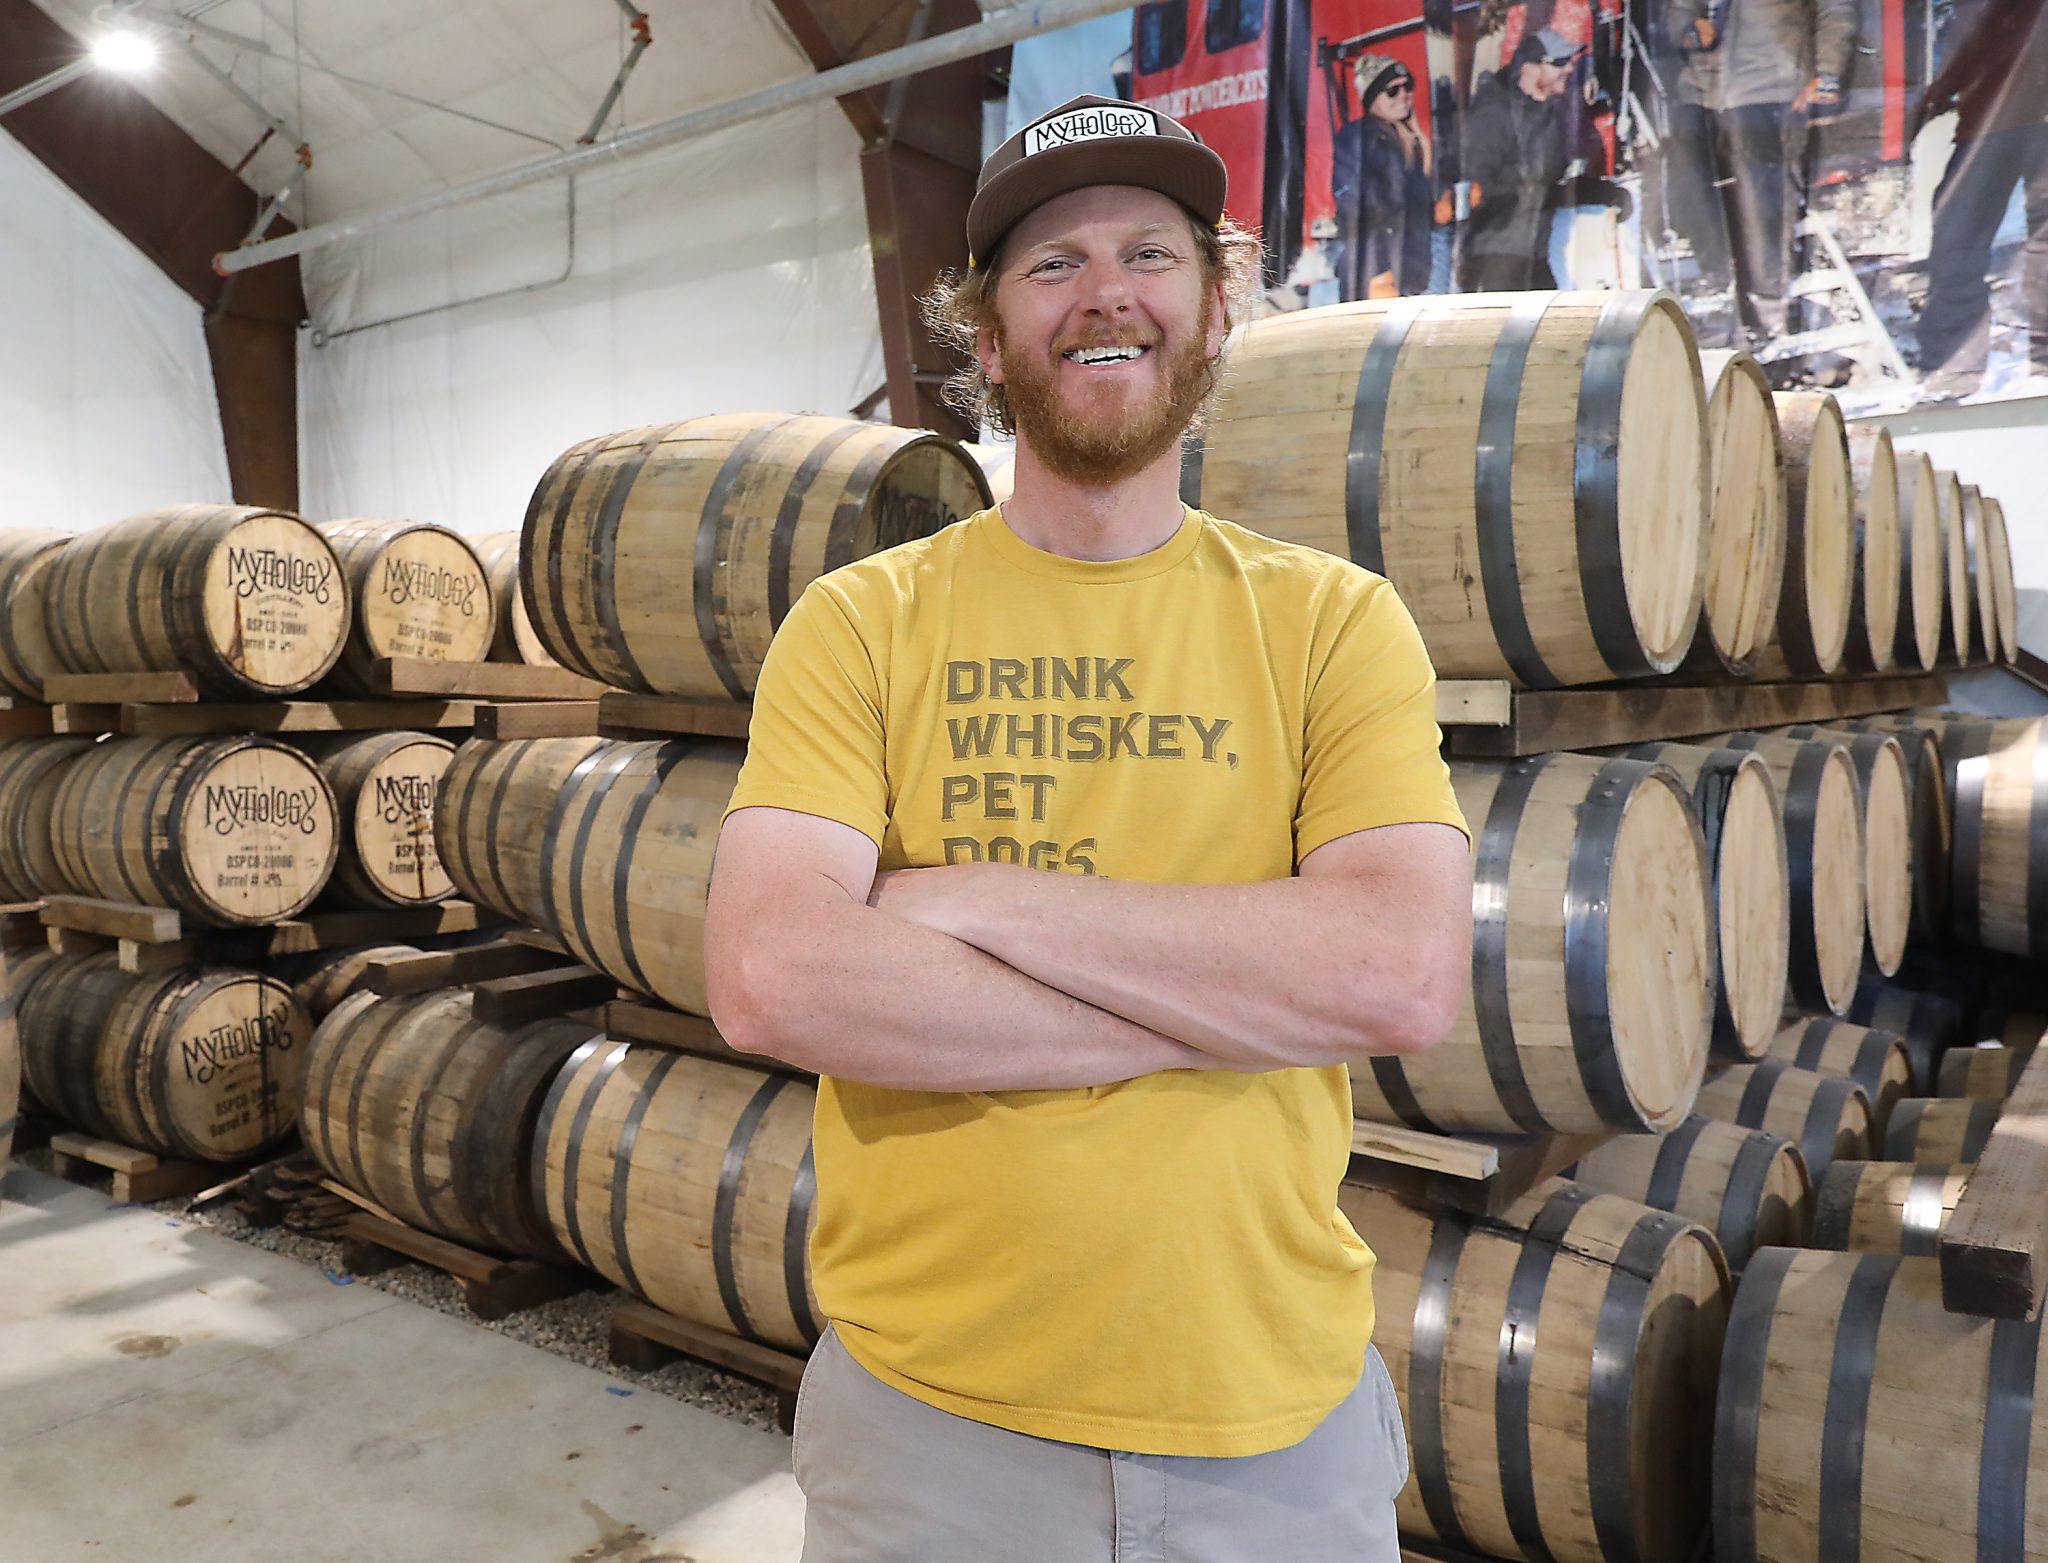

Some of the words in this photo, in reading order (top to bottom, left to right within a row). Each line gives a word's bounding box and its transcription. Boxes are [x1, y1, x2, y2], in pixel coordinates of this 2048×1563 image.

[1035, 110, 1148, 151] MYTHOLOGY
[226, 547, 331, 604] MYTHOLOGY
[383, 556, 477, 616] MYTHOLOGY
[945, 656, 1136, 704] DRINK
[945, 711, 1239, 770] WHISKEY,
[204, 785, 318, 835] MYTHOLOGY
[375, 775, 437, 823] MYTHOL
[941, 771, 1057, 823] PET
[942, 836, 1109, 879] DOGS
[180, 1002, 294, 1084] MYTHOLOGY
